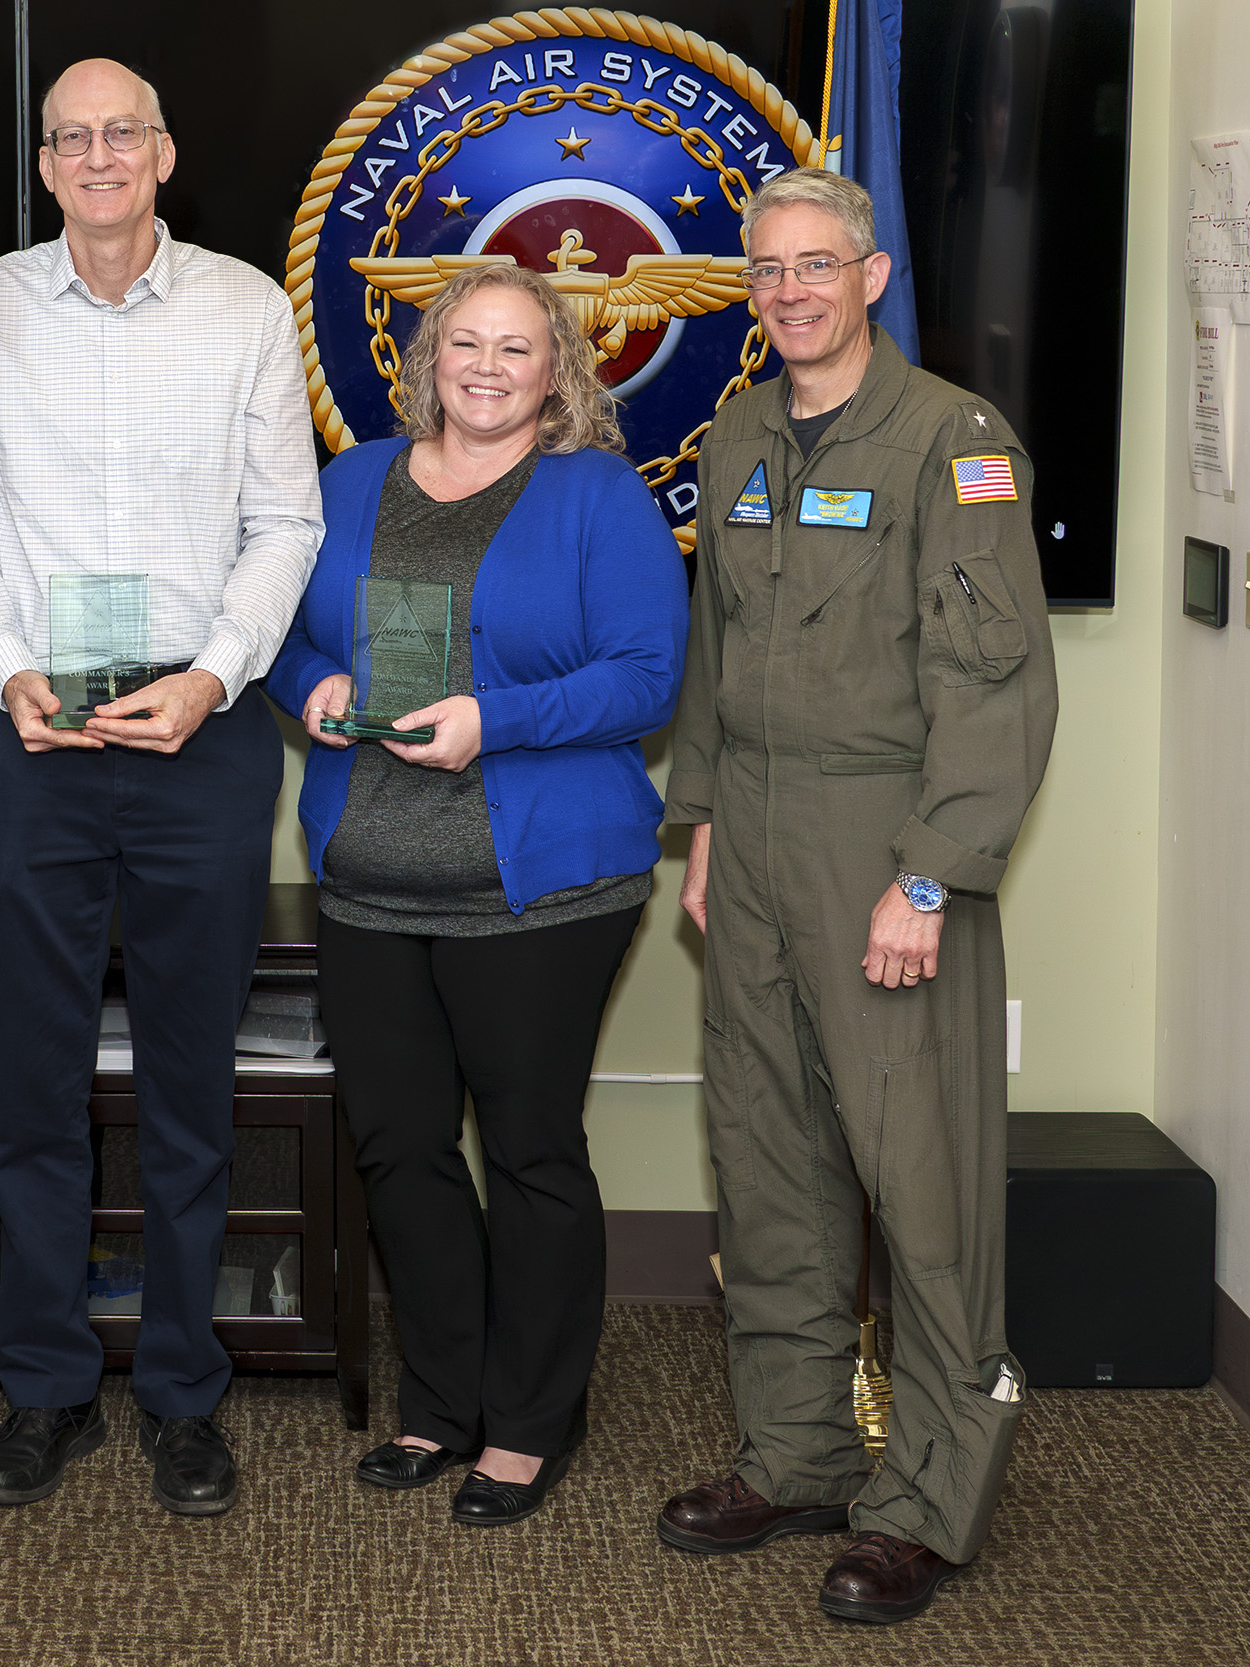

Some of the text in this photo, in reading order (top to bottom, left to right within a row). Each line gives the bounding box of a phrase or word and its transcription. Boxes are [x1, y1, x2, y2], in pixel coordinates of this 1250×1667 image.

[340, 49, 786, 221] NAVAL AIR SYSTEM
[738, 493, 768, 504] NAWC
[381, 626, 420, 638] NAWC
